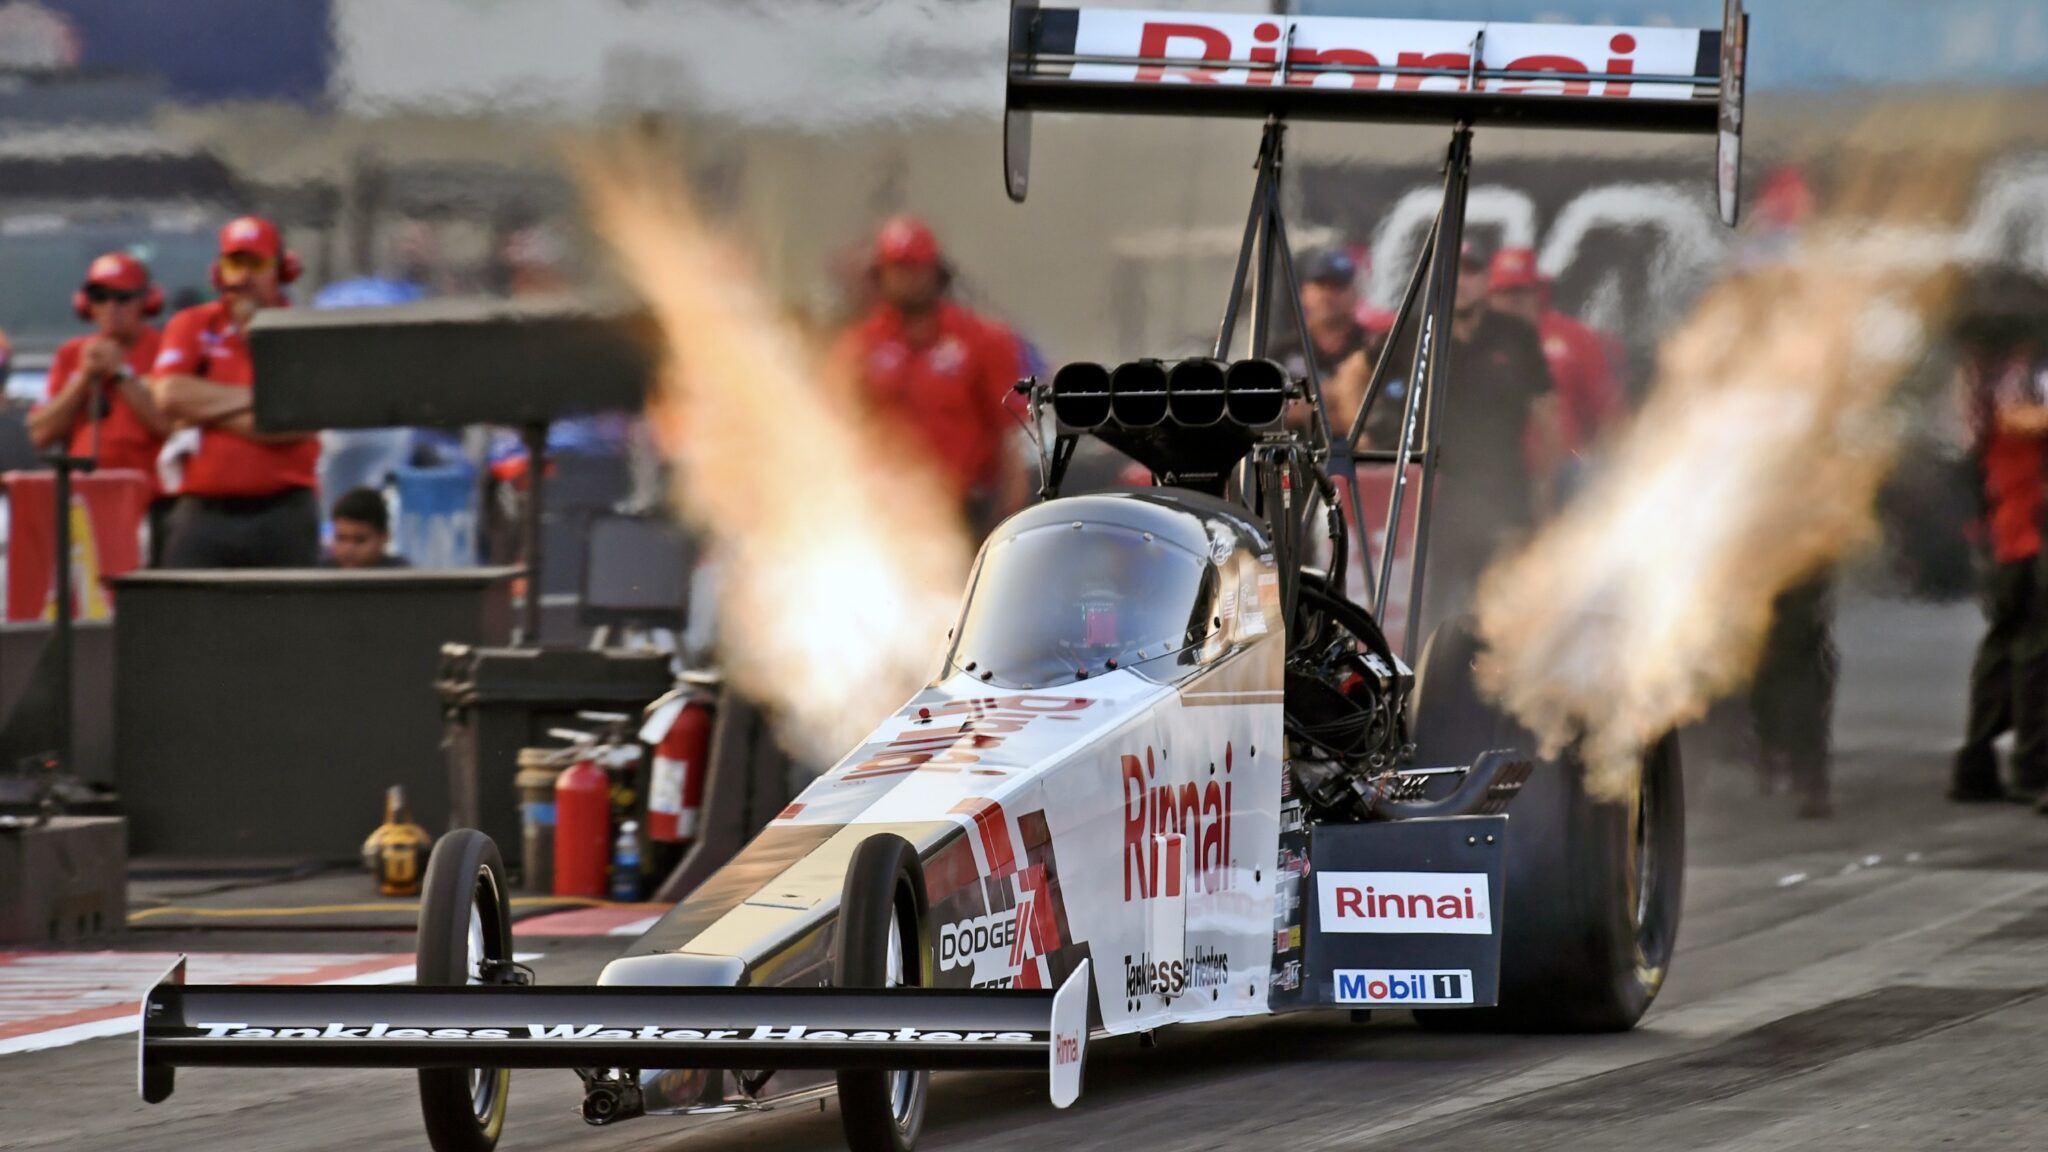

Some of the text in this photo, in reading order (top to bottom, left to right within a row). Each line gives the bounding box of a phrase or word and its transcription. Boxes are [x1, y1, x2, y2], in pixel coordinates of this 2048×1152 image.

[1134, 22, 1637, 97] Rinnai
[1121, 740, 1232, 902] Rinnai
[1336, 886, 1474, 919] Rinnai
[942, 918, 1016, 961] DODGE
[1124, 952, 1184, 998] Tankless
[1339, 974, 1426, 1000] Mobil
[197, 1022, 1034, 1042] Tankless Water Heaters
[1056, 1029, 1079, 1065] Rinnai
